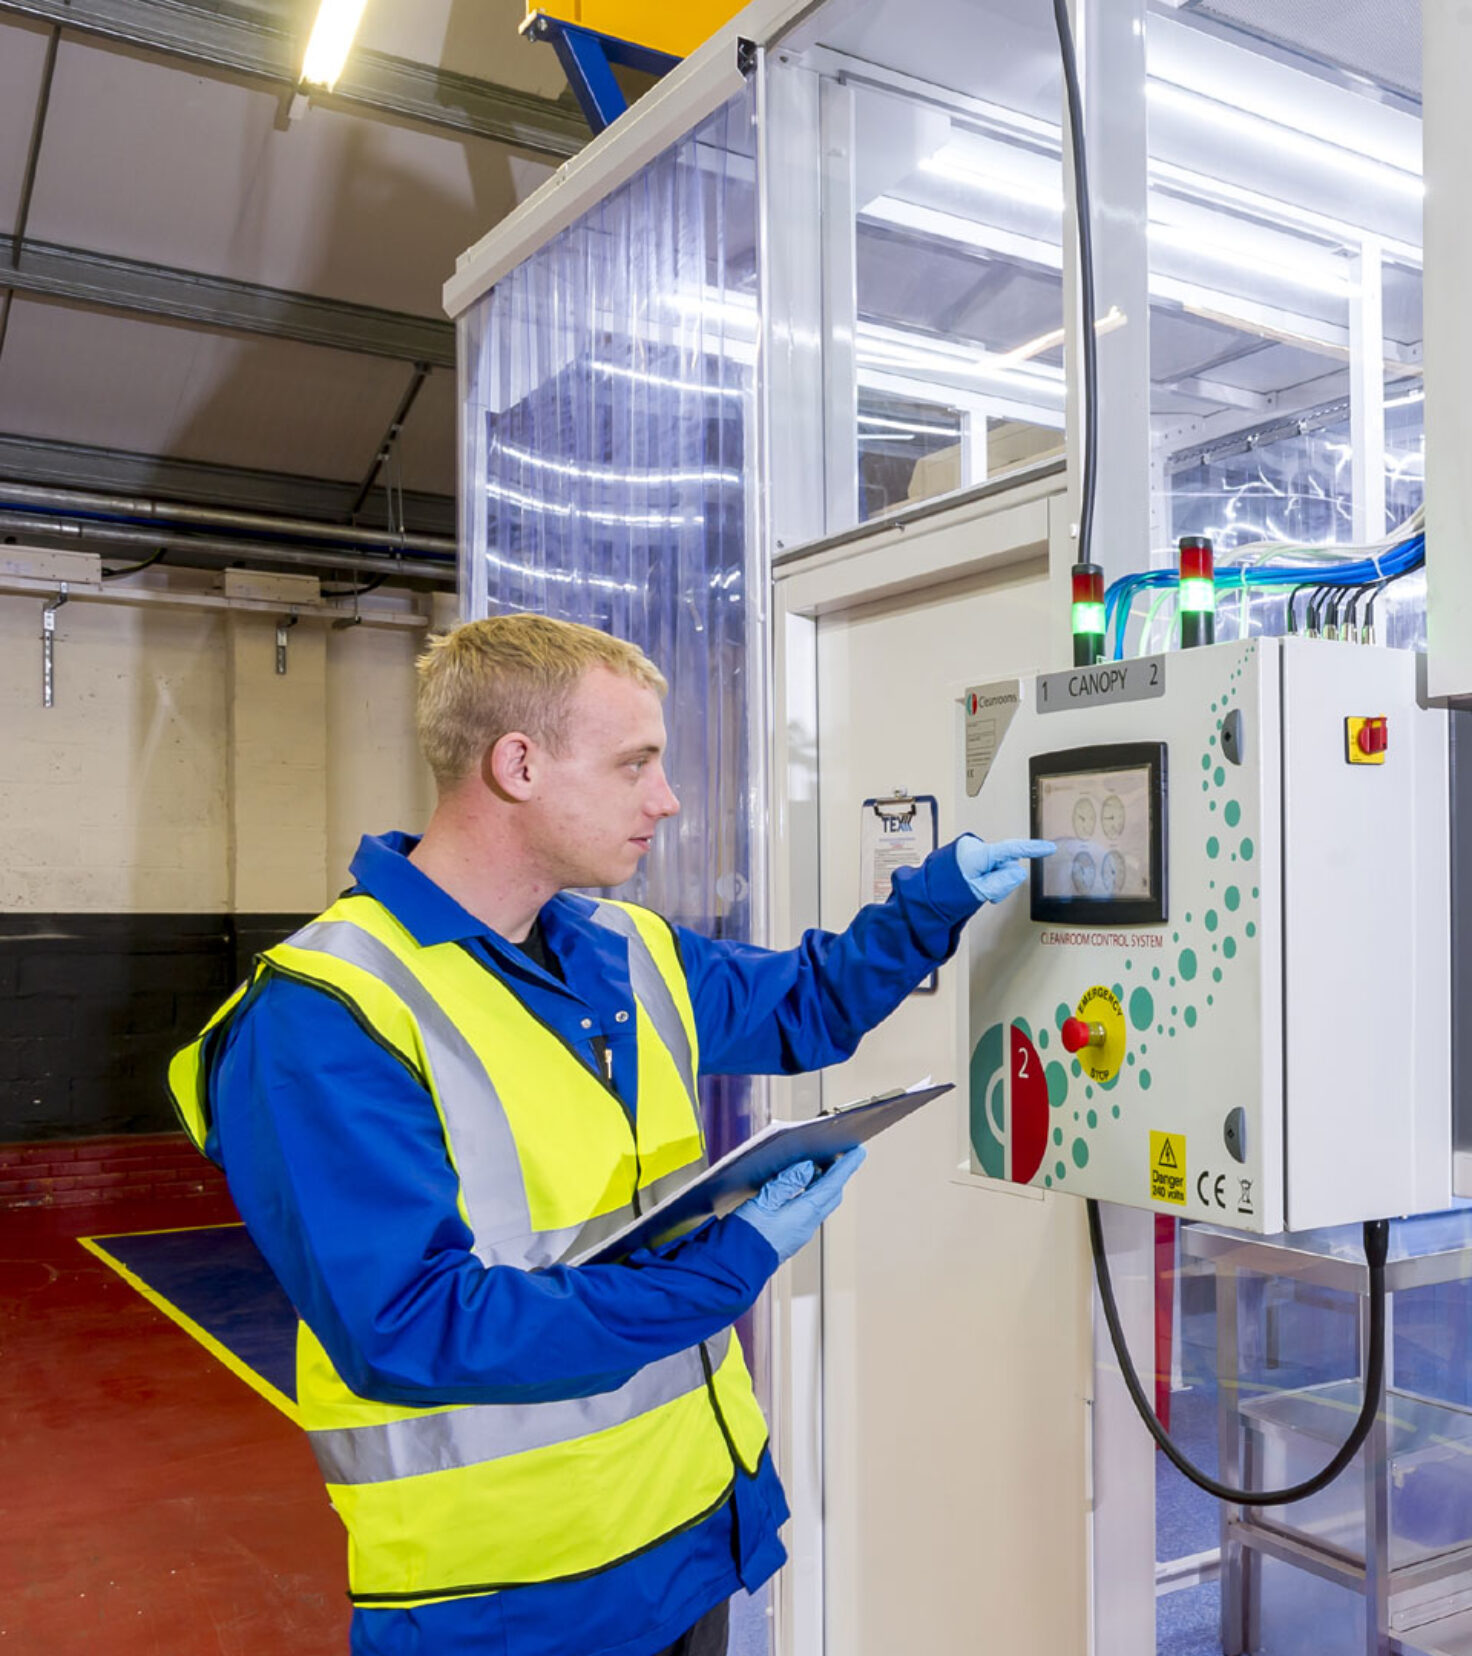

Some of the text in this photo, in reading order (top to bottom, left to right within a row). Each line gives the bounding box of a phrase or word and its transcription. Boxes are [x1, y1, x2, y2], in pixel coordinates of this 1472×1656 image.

[1042, 663, 1158, 702] 1 CANOPY 2
[1040, 931, 1163, 948] CLEANROOM CONTROL SYSTEM
[1077, 986, 1123, 1017] EMERGENCY
[1017, 1047, 1030, 1080] 2
[1090, 1066, 1110, 1082] STOP
[1152, 1168, 1184, 1189] Danger
[1197, 1170, 1226, 1209] CE
[1152, 1184, 1185, 1202] 240 volts
